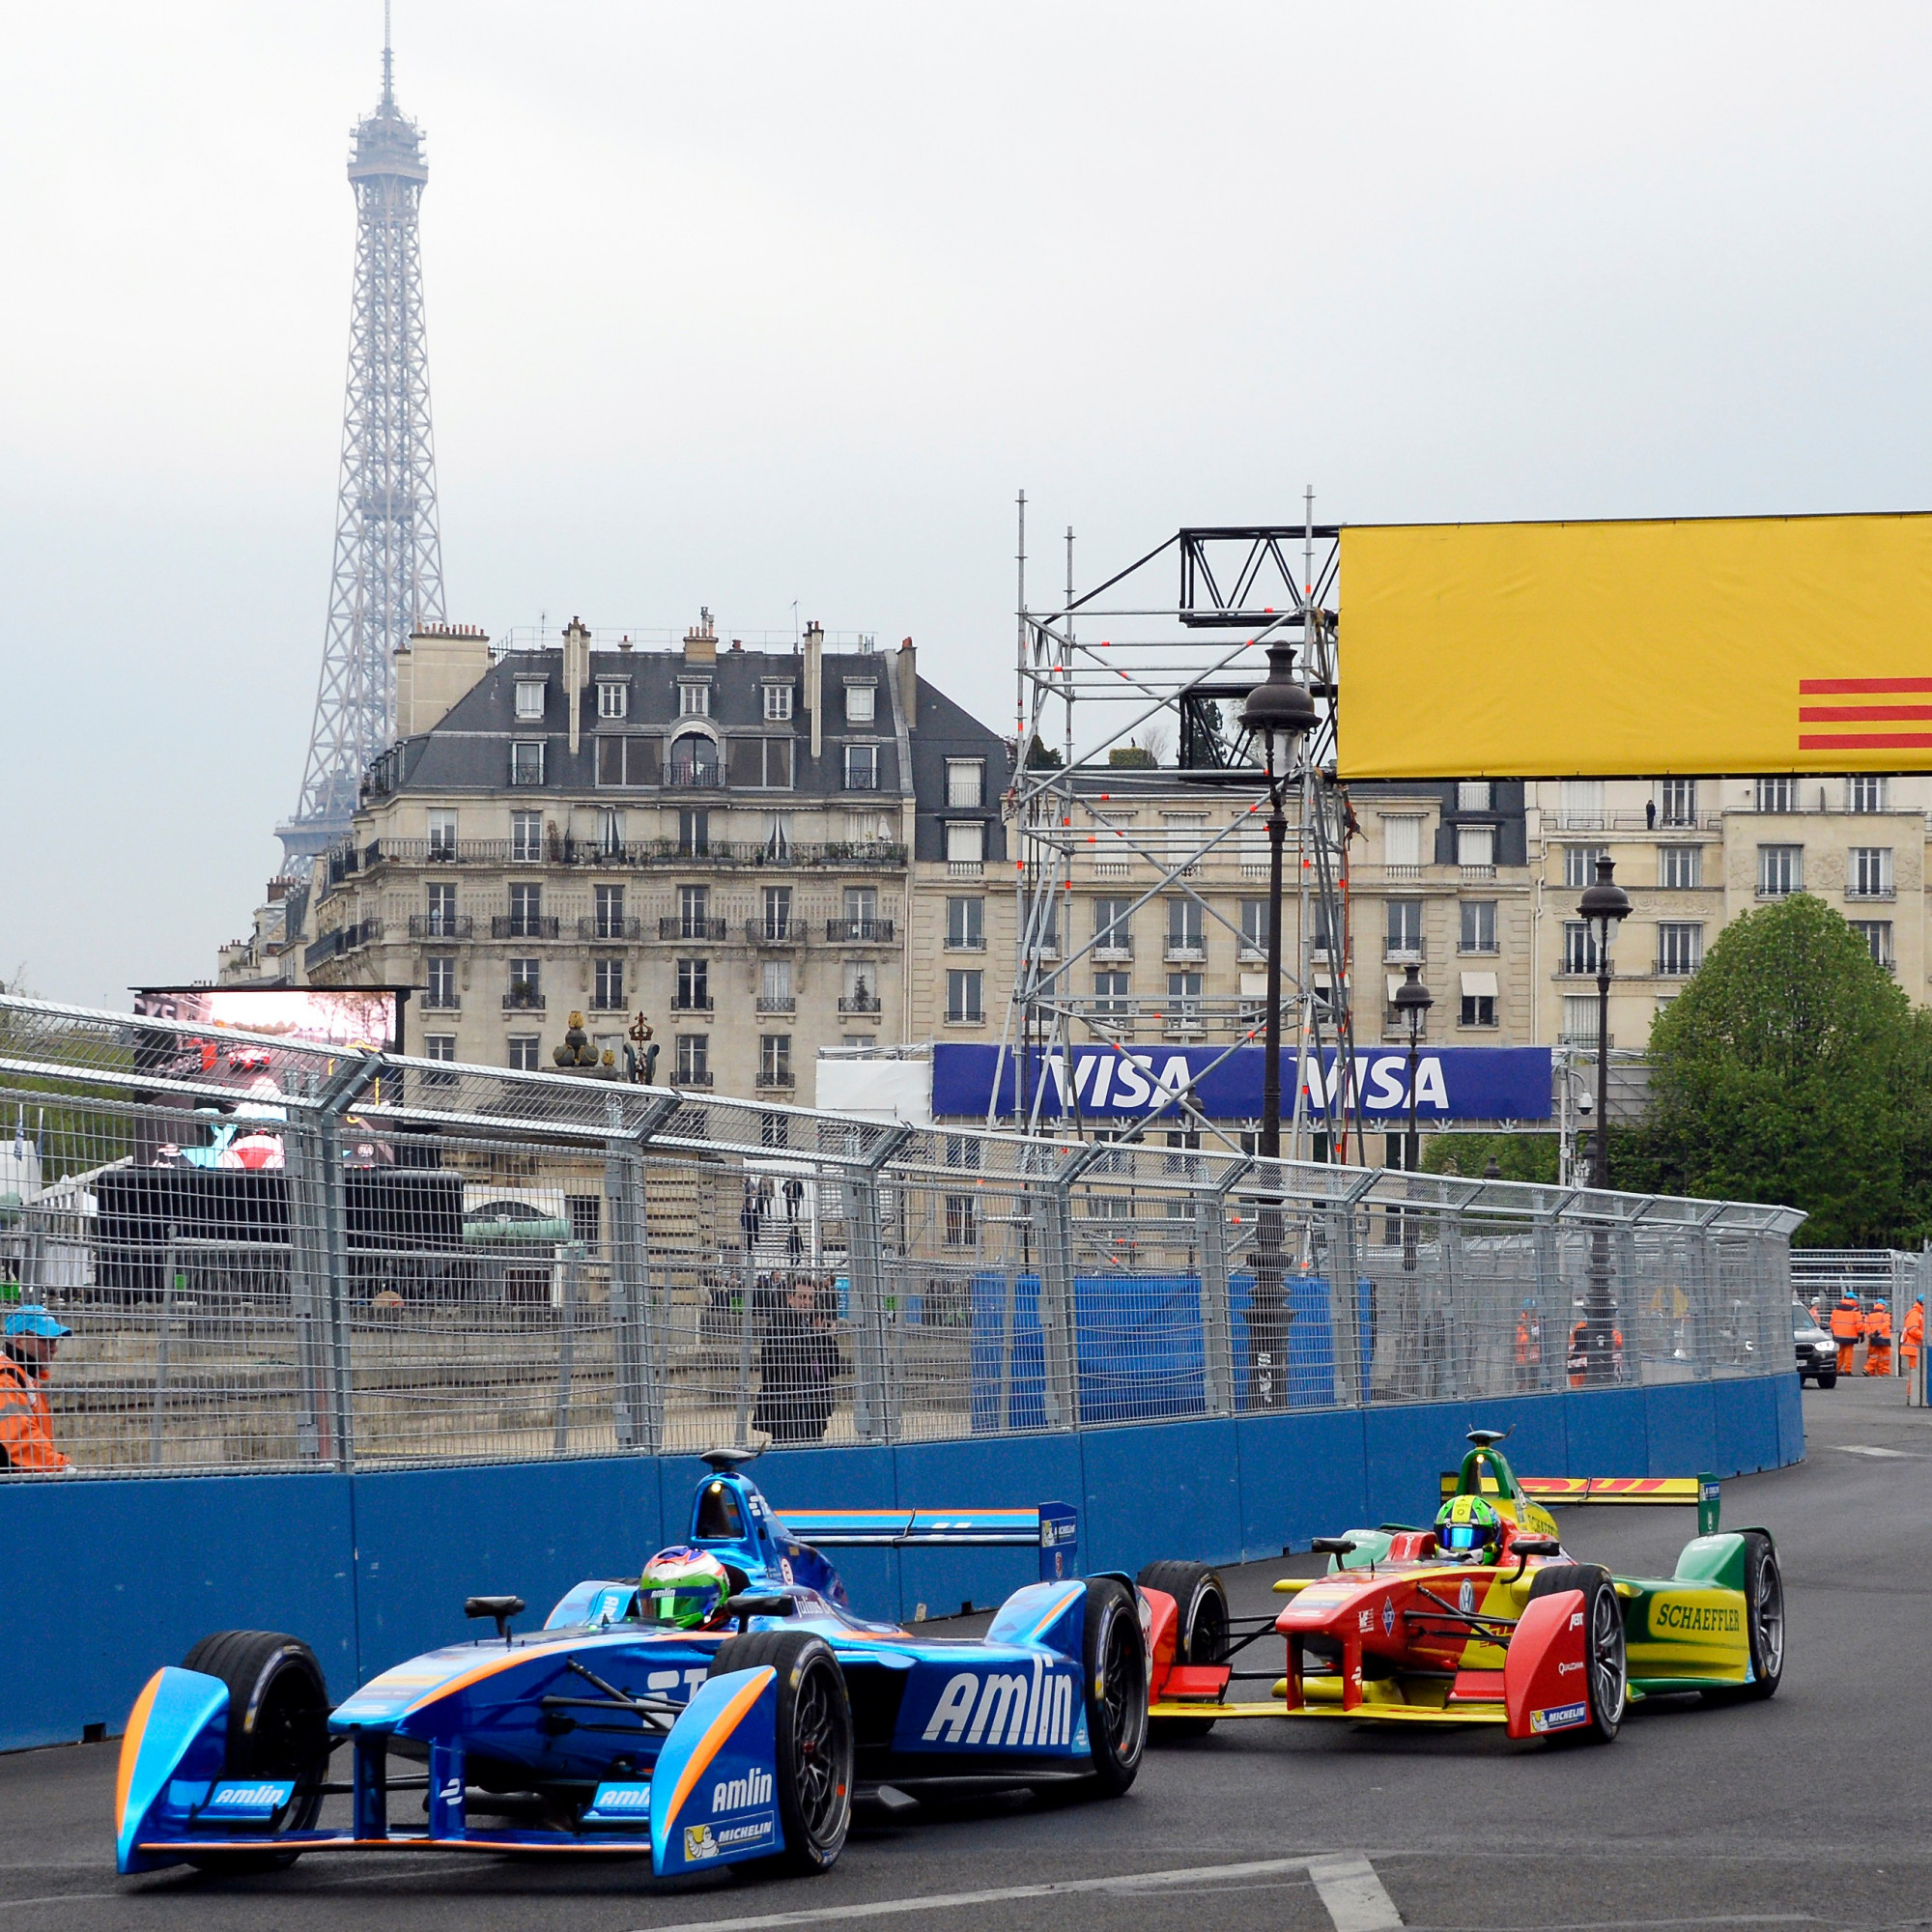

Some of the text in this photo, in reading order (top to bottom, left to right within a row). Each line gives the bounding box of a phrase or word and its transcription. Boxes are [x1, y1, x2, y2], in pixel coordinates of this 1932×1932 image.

[1036, 1055, 1192, 1108] VISA
[1289, 1056, 1450, 1109] VISA
[1656, 1604, 1740, 1632] SCHAEFFLER
[1548, 1706, 1585, 1722] MICHELIN
[599, 1786, 650, 1805] Aml
[718, 1821, 773, 1843] MICHELIN
